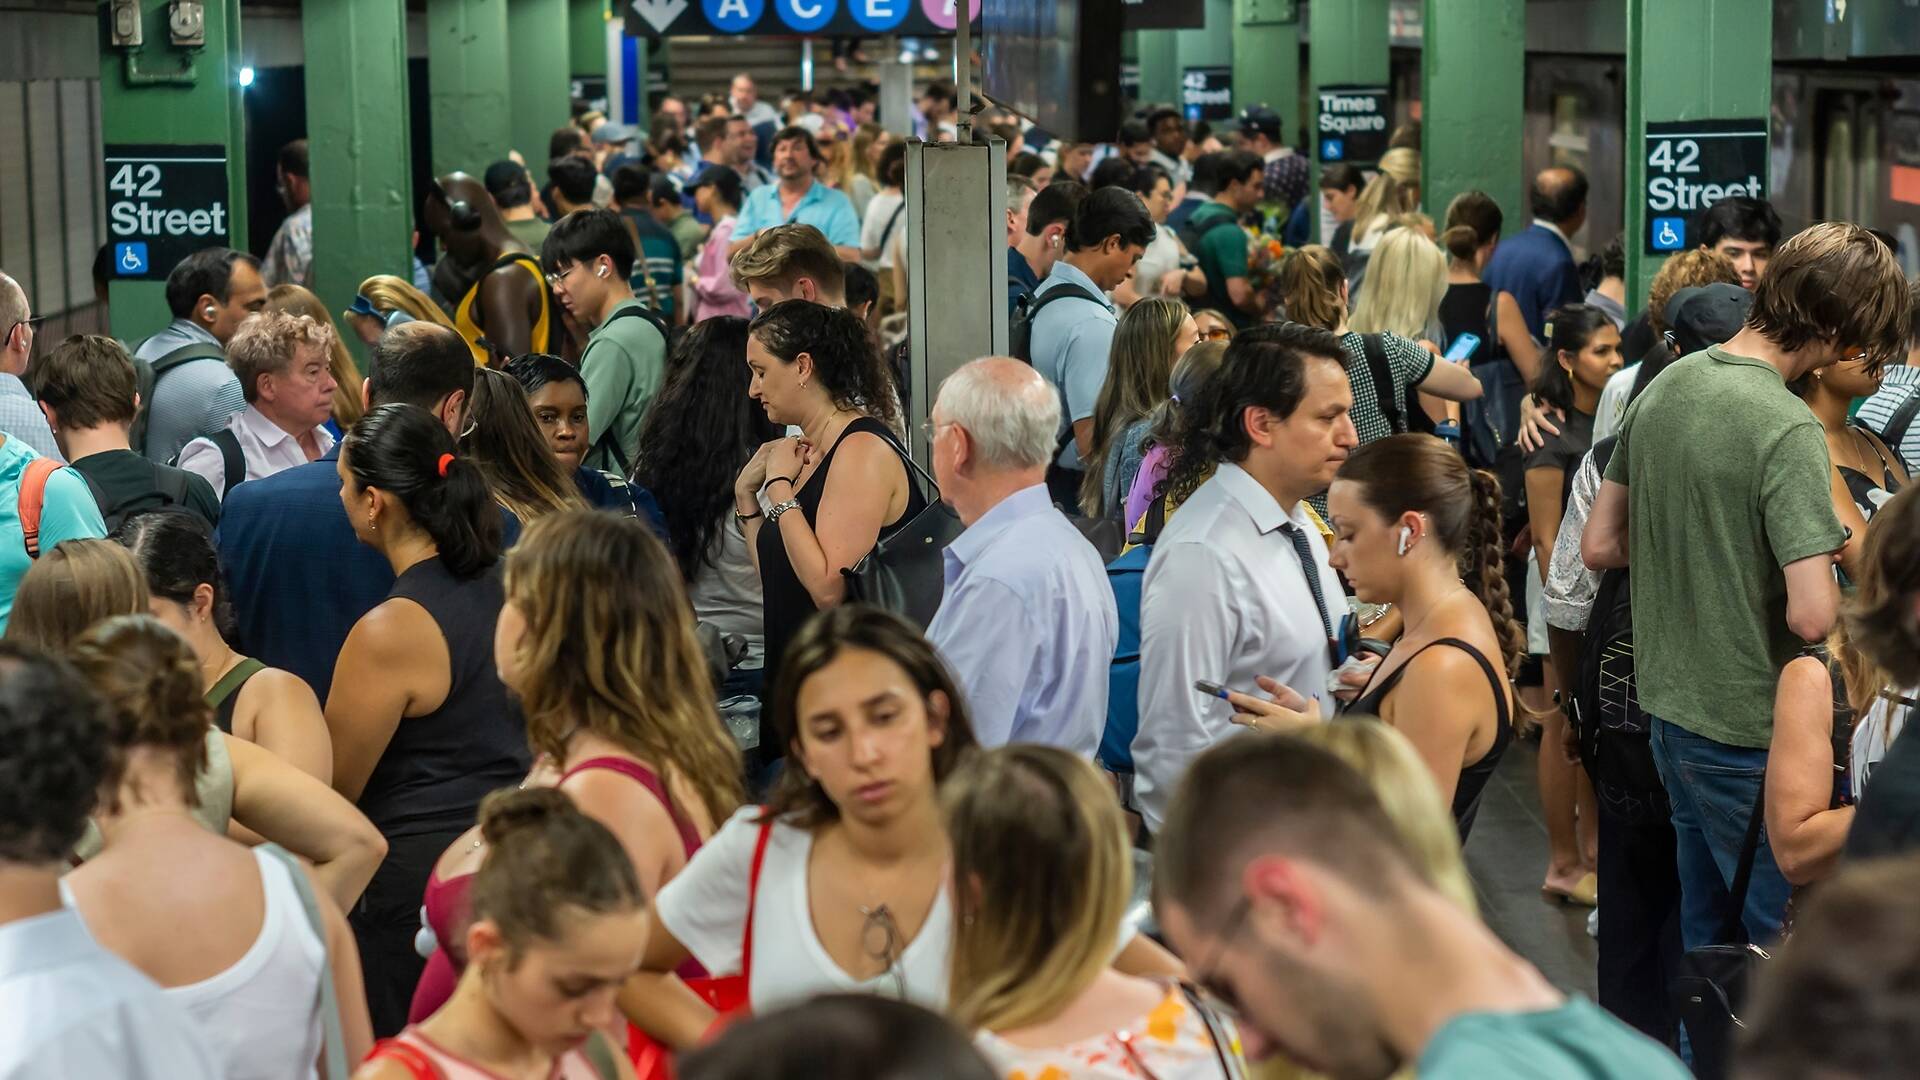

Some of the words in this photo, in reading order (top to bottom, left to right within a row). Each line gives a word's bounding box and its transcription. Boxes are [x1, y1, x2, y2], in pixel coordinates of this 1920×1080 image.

[1320, 95, 1376, 112] Times
[1320, 113, 1386, 135] Square
[1648, 139, 1700, 173] 42
[110, 163, 163, 197] 42
[1648, 175, 1762, 211] Street
[111, 201, 226, 236] Street
